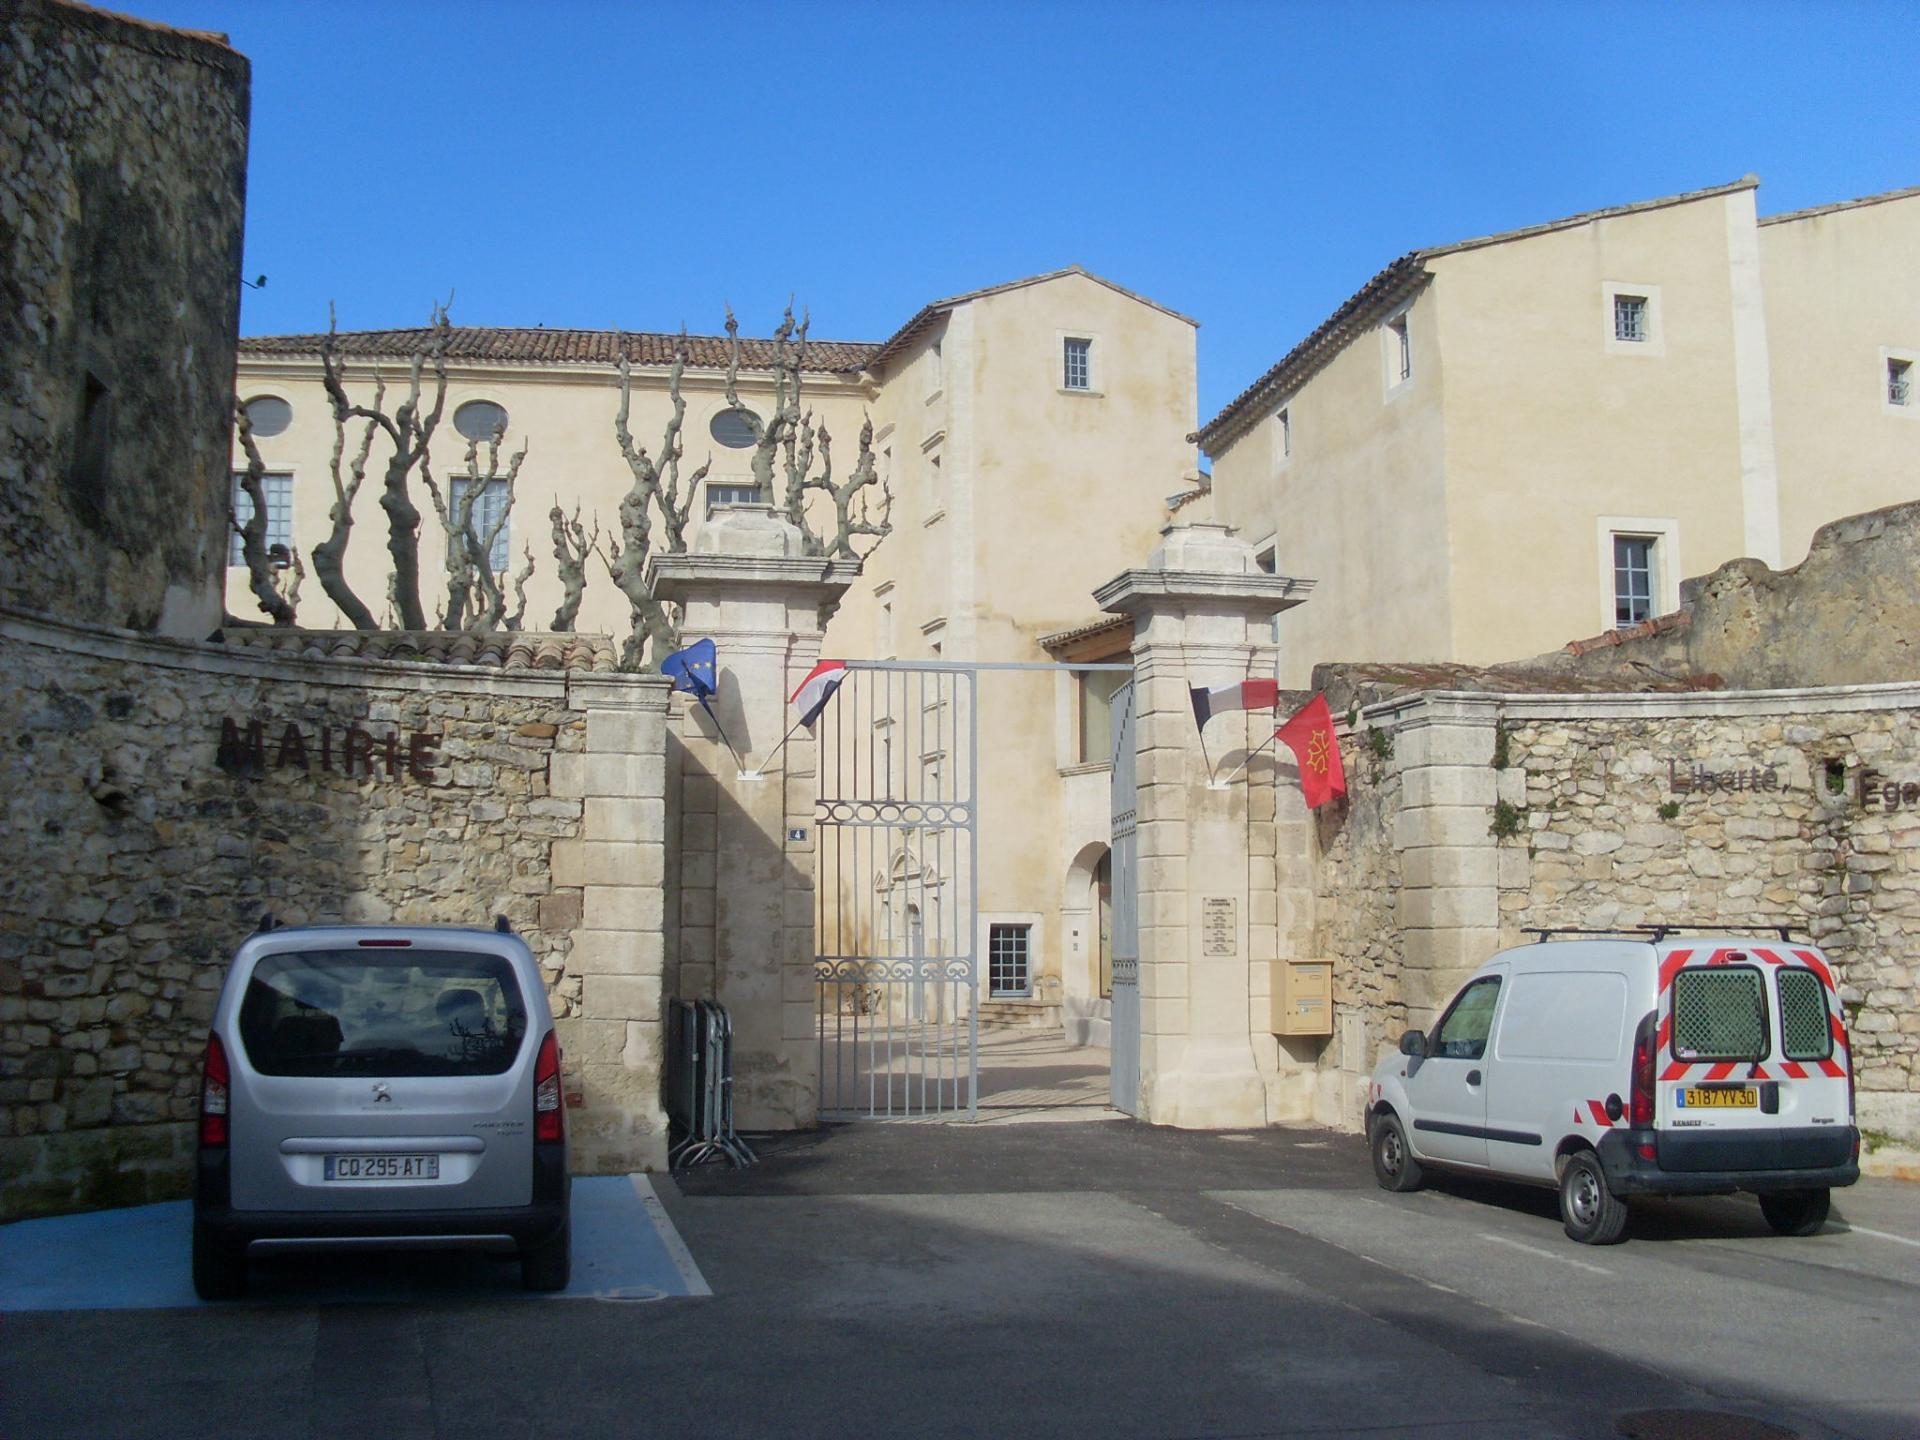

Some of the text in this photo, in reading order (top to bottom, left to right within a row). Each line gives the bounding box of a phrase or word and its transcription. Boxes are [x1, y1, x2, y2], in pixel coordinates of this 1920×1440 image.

[216, 717, 443, 780] MAIRIE
[1687, 1089, 1754, 1105] 3187 YV 30
